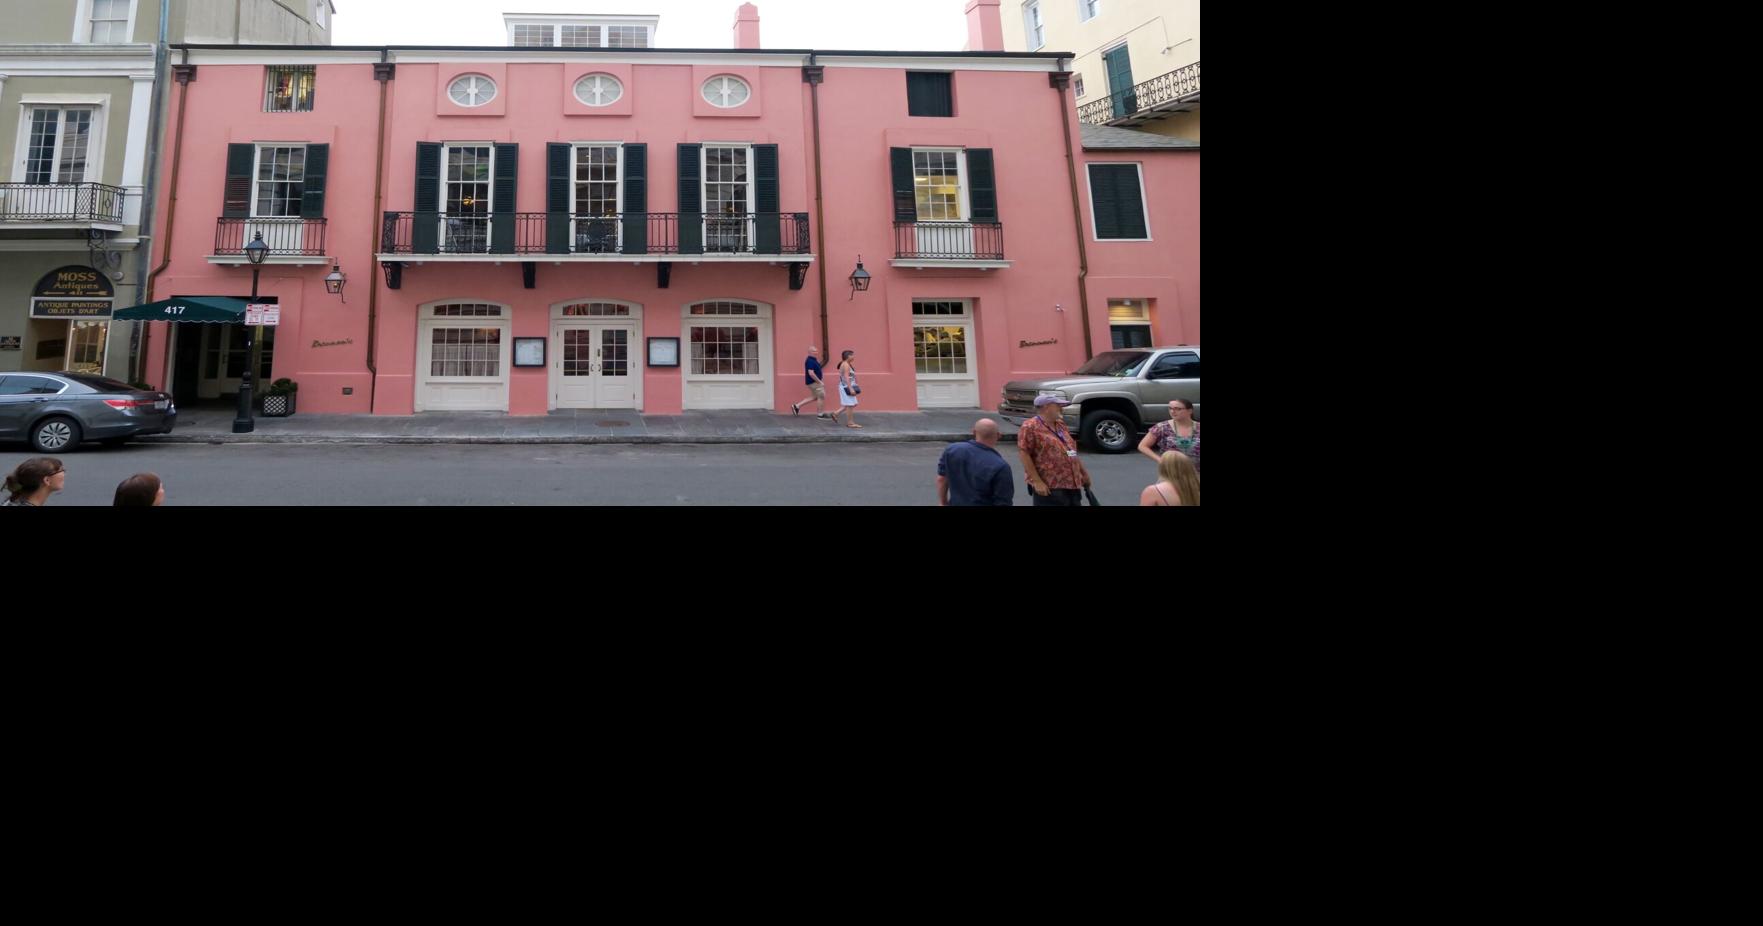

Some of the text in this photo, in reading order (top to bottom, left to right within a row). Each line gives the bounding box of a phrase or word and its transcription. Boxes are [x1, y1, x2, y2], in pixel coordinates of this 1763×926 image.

[57, 272, 97, 281] MOSS
[53, 281, 99, 293] Antiques
[164, 306, 186, 315] 417
